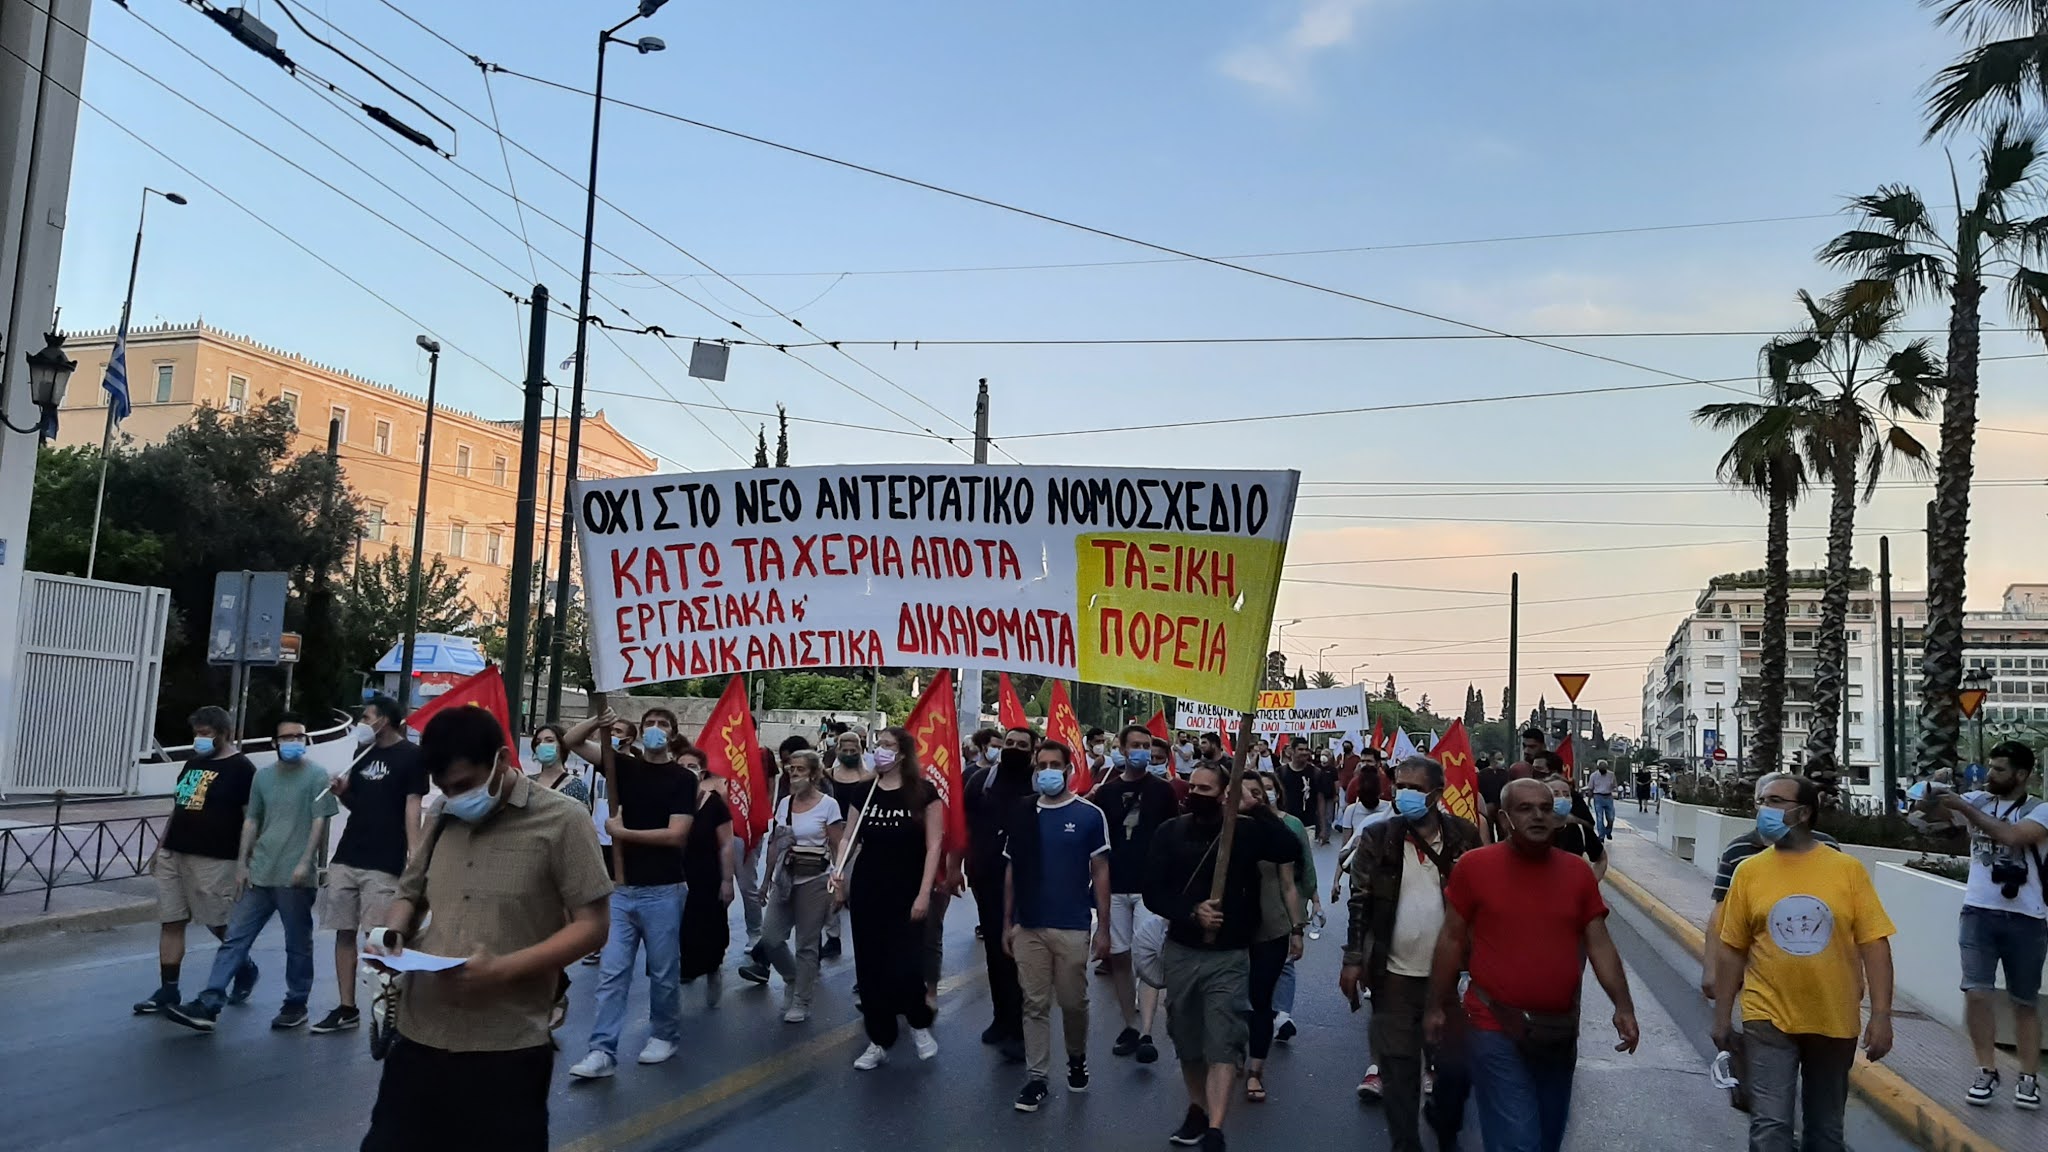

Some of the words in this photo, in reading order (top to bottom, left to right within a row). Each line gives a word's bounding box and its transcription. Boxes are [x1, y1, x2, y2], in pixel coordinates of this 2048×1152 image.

[582, 488, 645, 535] ΟΧΙ
[653, 483, 721, 530] ΣΤΟ
[735, 477, 802, 527] ΝΕΟ
[816, 474, 1034, 525] ΑΝΤΕΡΓΑΤΙΚΟ
[1047, 476, 1270, 536] ΝΟΜΟΣΧΕΔΙΟ
[731, 537, 785, 584] ΤΑ
[792, 532, 904, 580] ΧΕΡΙΑ
[1090, 538, 1237, 599] ΤΑΞΙΚΗ
[616, 587, 785, 644] ΕΡΓΑΣΙΑΚΑ
[1099, 608, 1229, 677] ΠΟΡΕΙΑ
[619, 629, 885, 684] ΣΥΝΔΙΚΑΛΙΣΤΙΚΑ
[1177, 700, 1195, 714] ΜΑΣ
[1198, 703, 1234, 717] ΚΛΕΒΟΥΝ
